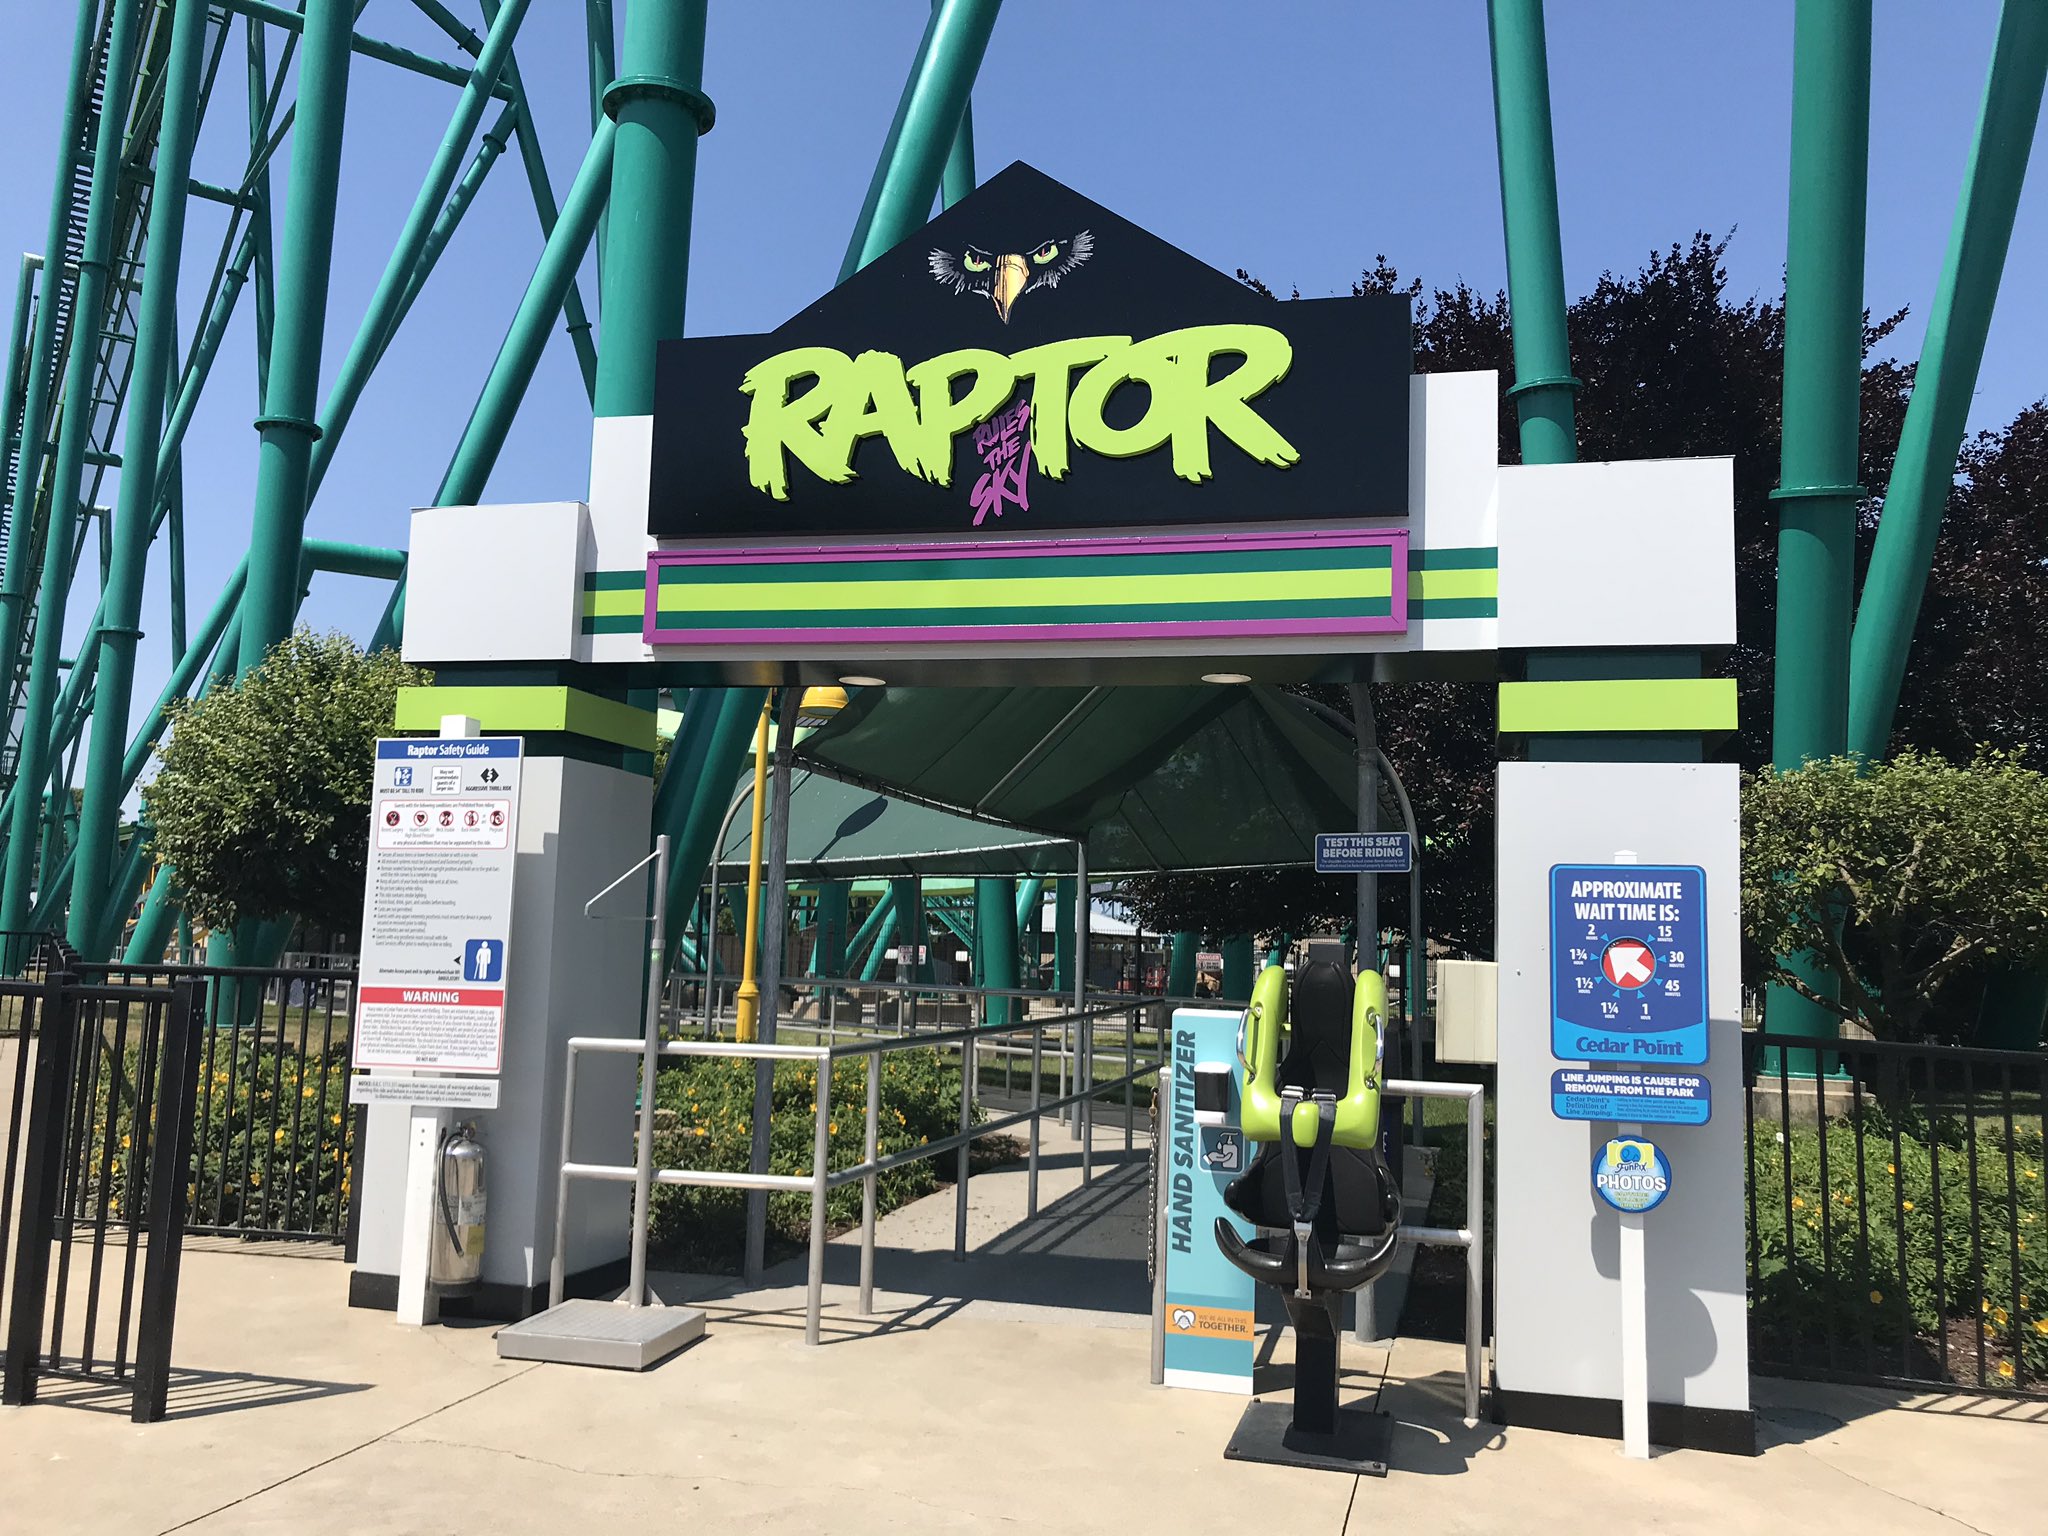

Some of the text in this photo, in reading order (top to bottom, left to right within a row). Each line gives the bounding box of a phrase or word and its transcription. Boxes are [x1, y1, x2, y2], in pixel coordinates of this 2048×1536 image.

[738, 323, 1301, 501] RAPTOR
[972, 399, 1031, 455] RULES
[984, 436, 1020, 470] THE
[970, 440, 1031, 526] SKY
[407, 743, 490, 758] Raptor Safety Guide
[1325, 836, 1401, 847] TEST THIS SEAT
[1323, 847, 1403, 858] BEFORE RIDING
[1571, 880, 1682, 899] APPROXIMATE
[1574, 903, 1680, 922] WAIT TIME IS:
[1588, 924, 1596, 935] 2
[1657, 925, 1672, 937] 15
[1669, 951, 1685, 963] 30
[1665, 980, 1680, 992] 45
[403, 990, 460, 1004] WARNING
[1642, 1003, 1648, 1015] 1
[1576, 1036, 1684, 1055] Cedar Point
[1561, 1073, 1700, 1087] LINE JUMPING IS CAUSE FOR
[1565, 1083, 1695, 1097] REMOVAL FROM THE PARK
[1171, 1029, 1196, 1254] HAND SANITIZER
[1596, 1173, 1667, 1192] PHOTOS
[1198, 1320, 1248, 1333] TOGETHER.
